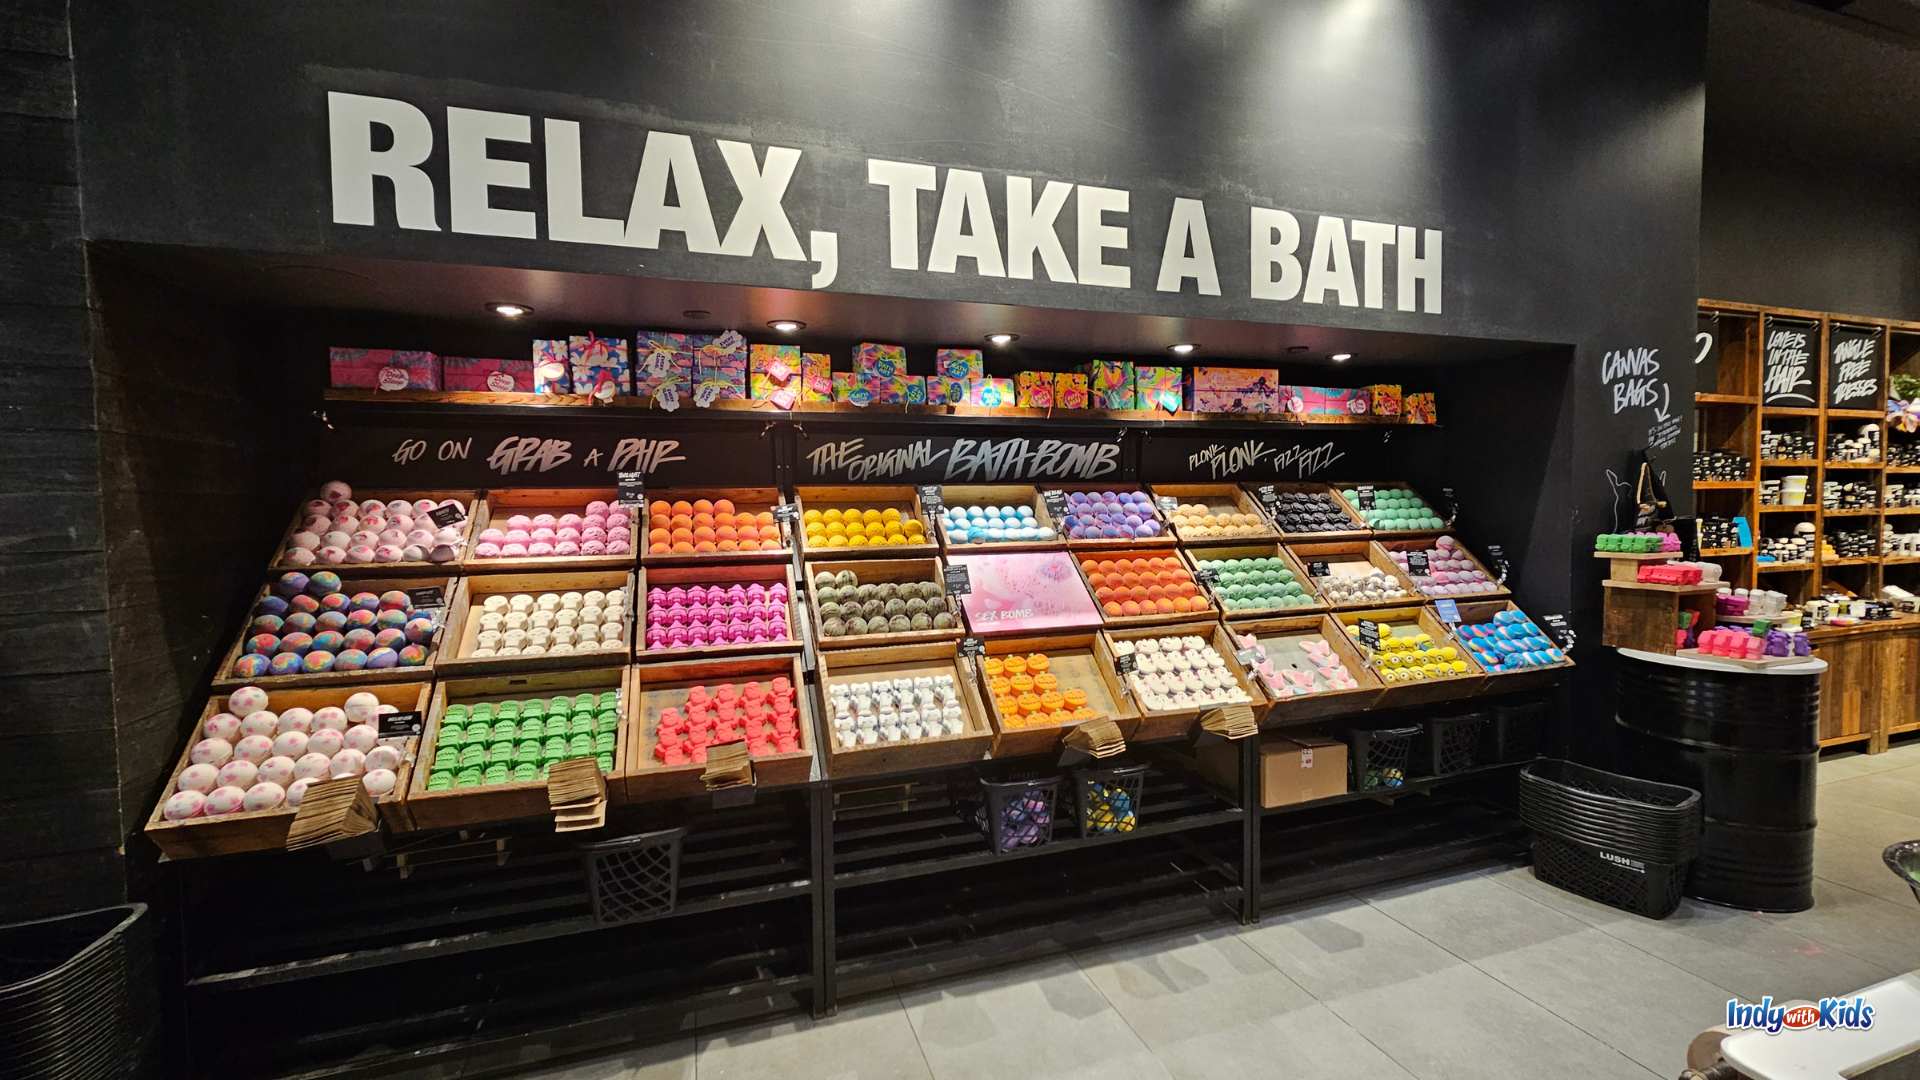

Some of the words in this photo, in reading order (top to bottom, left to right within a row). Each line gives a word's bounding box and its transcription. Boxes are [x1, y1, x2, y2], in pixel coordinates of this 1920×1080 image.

[328, 91, 838, 289] RELAX,
[868, 158, 1131, 288] TAKE
[1156, 197, 1221, 296] A
[1250, 206, 1442, 314] BATH
[1766, 330, 1796, 351] LOVE
[1794, 332, 1807, 349] IS
[1767, 348, 1783, 366] IN
[1781, 348, 1810, 366] THE
[1602, 347, 1660, 385] CANVAS
[1764, 364, 1812, 394] HAIR
[1838, 359, 1872, 383] FREE
[1614, 378, 1659, 414] BAGS
[392, 439, 427, 465] GO
[438, 437, 472, 461] ON
[486, 436, 572, 475] GRAB
[583, 448, 604, 467] A
[607, 438, 687, 474] PAIR
[806, 438, 864, 476] THE
[848, 439, 950, 481] ORIGINAL
[1189, 444, 1225, 471] PLONK
[1274, 444, 1308, 473] FIZZ
[1298, 441, 1346, 480] FIZZ
[1600, 851, 1630, 866] LUSH
